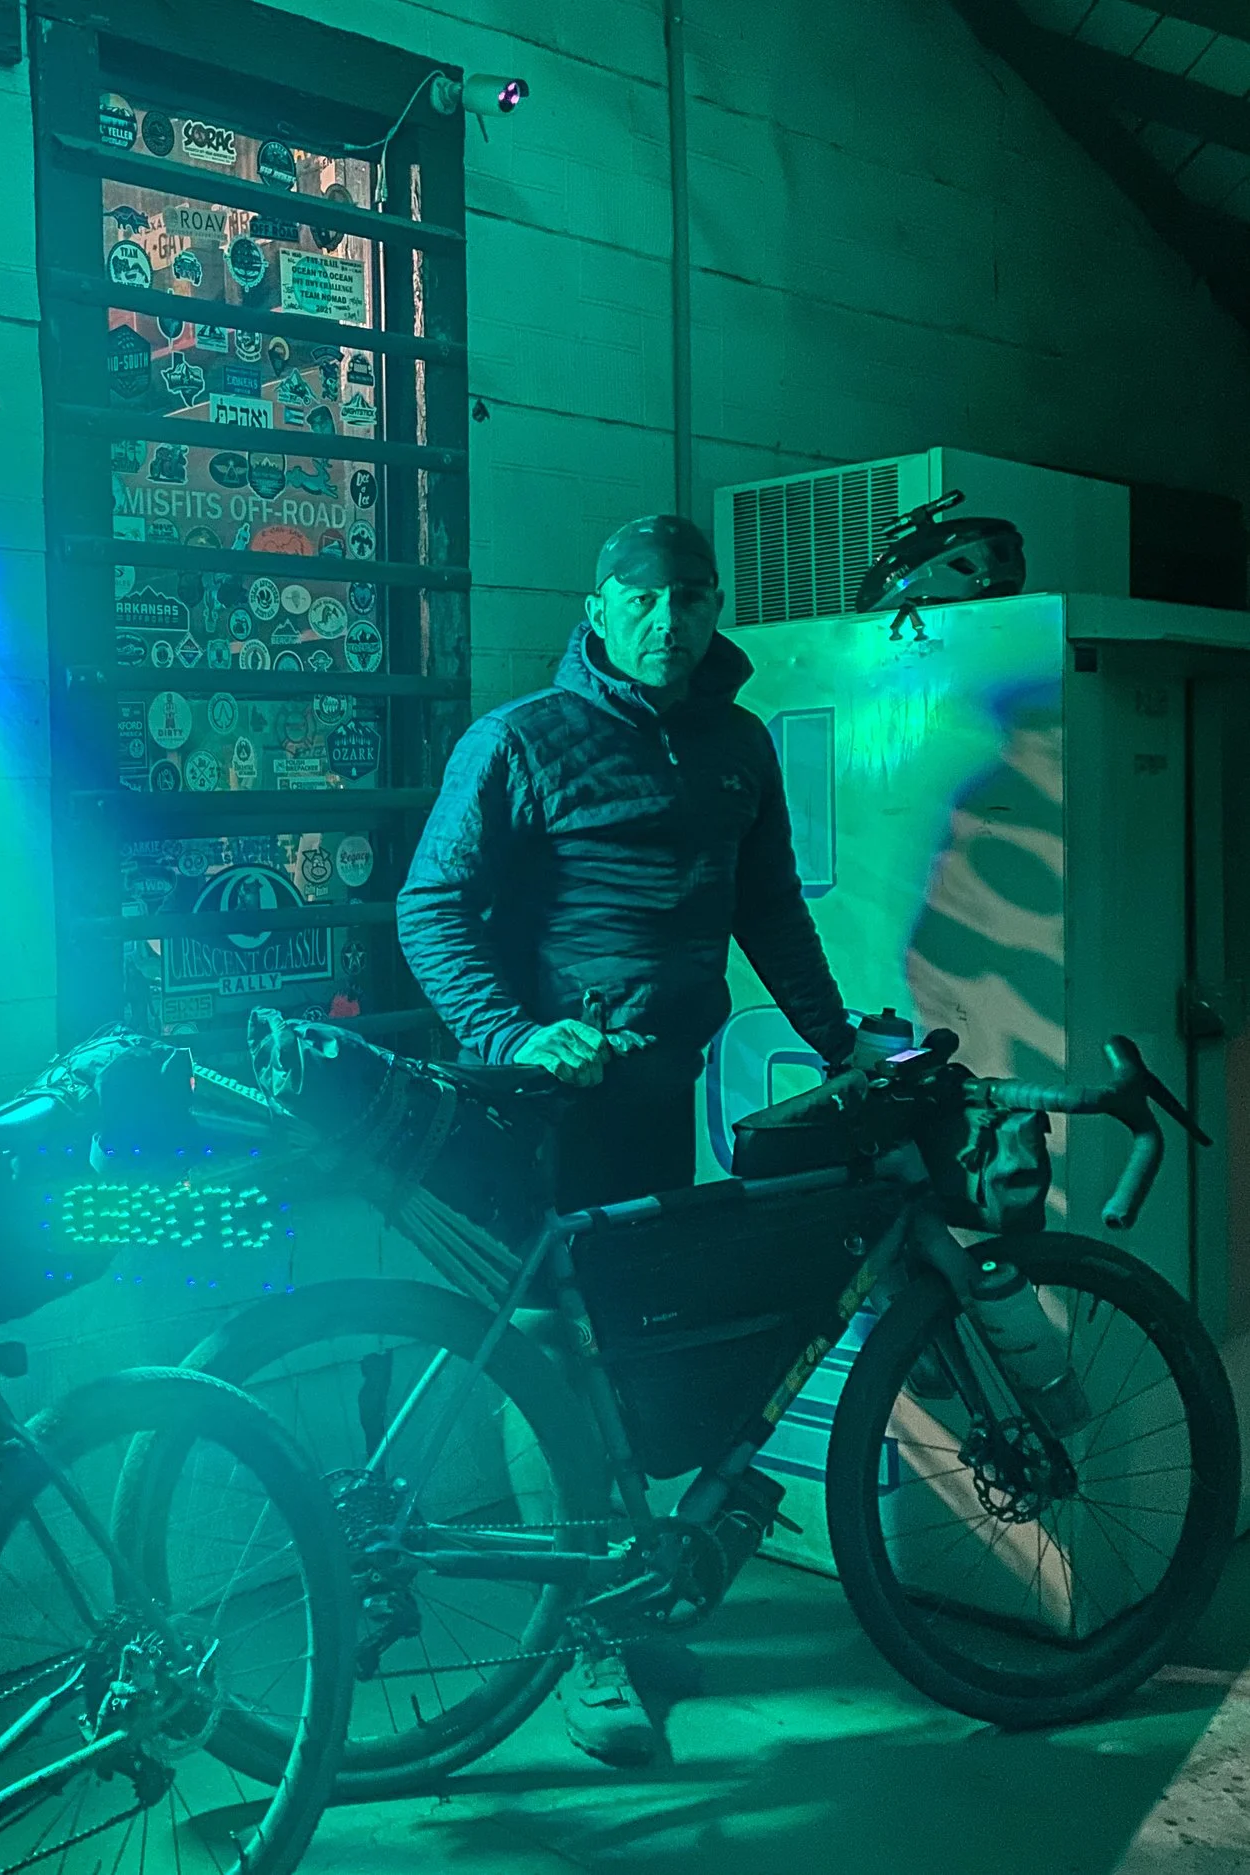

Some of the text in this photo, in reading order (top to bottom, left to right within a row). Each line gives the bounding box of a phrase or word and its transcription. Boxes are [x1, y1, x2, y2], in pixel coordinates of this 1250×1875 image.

[292, 266, 353, 283] OCEAN TO OCEAN
[300, 290, 347, 304] TEAM NOMAD
[124, 487, 347, 529] MISFITS OFF-ROAD
[116, 603, 179, 616] ARKANSAS
[332, 748, 374, 761] OZARK
[170, 928, 326, 980] CRESCENT CLASSIC
[222, 974, 279, 993] RALLY
